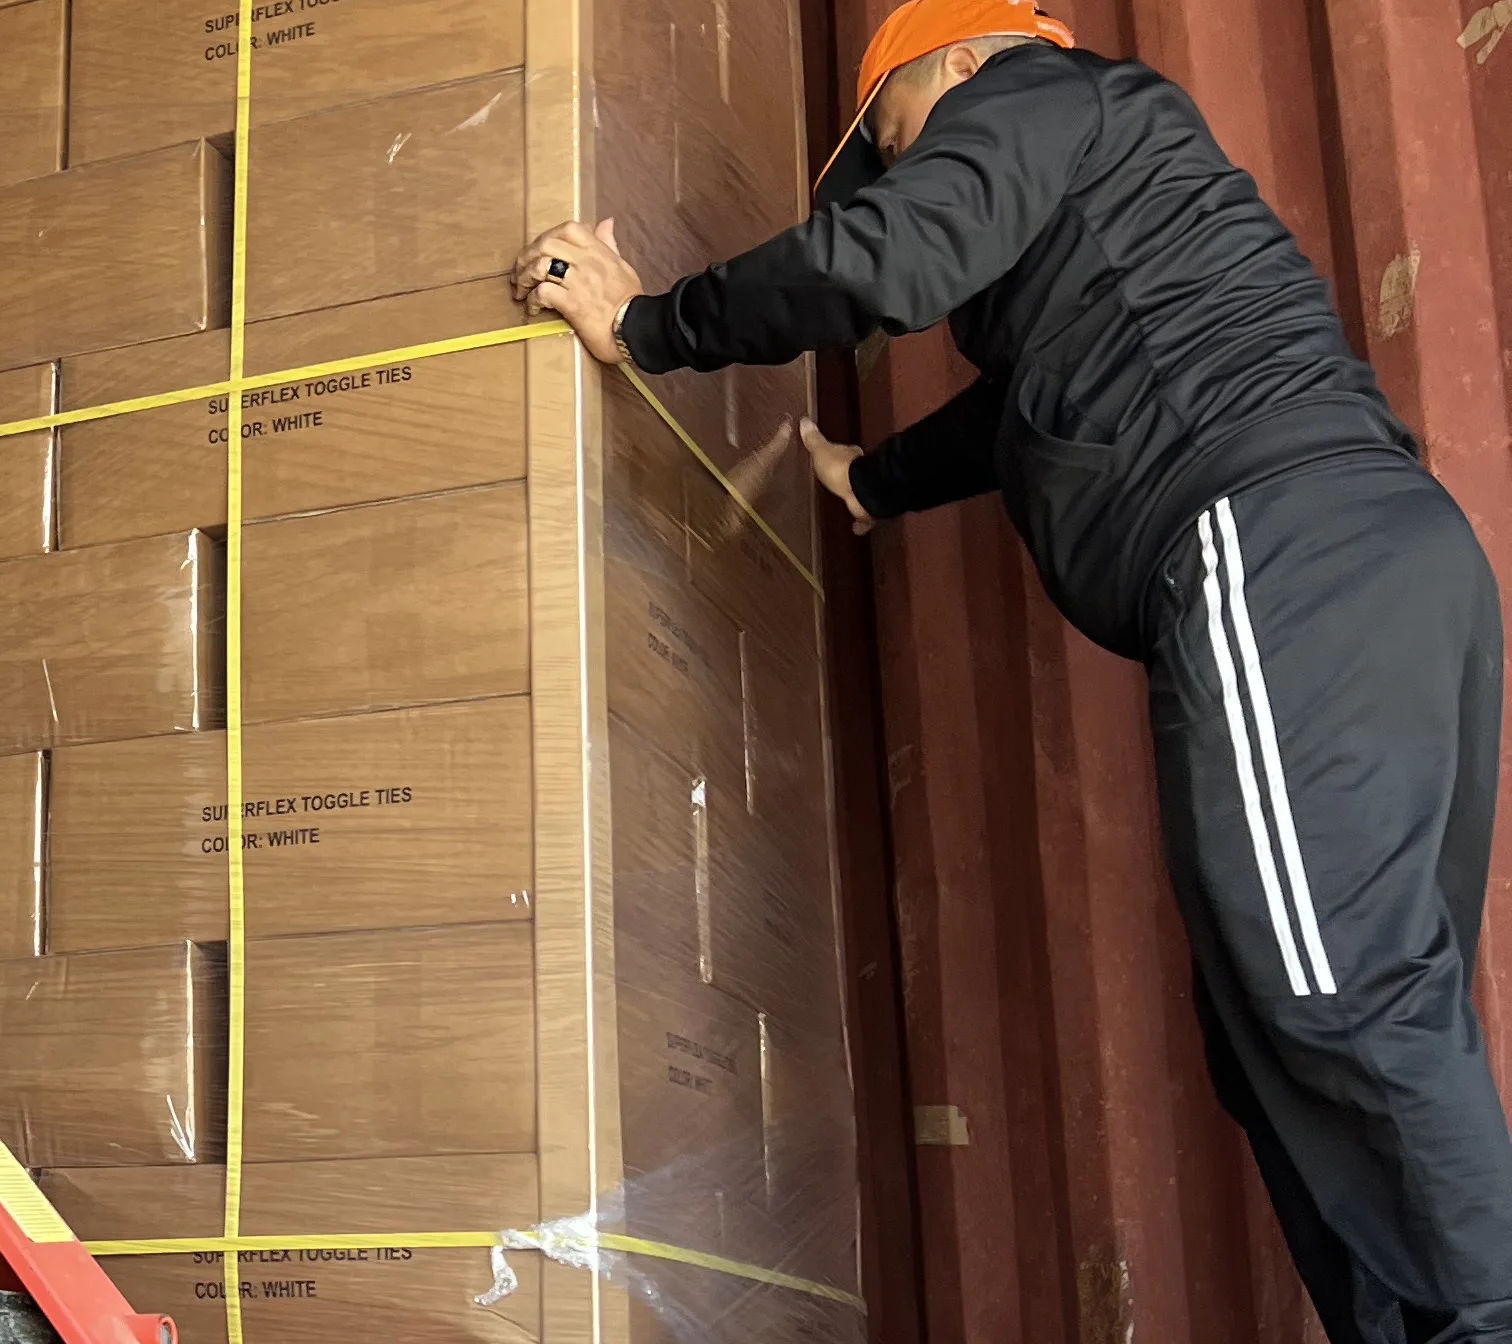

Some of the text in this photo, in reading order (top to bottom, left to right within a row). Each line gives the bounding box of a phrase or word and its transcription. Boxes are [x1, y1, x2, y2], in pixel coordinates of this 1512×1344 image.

[267, 22, 316, 46] WHITE
[208, 366, 412, 414] SUERFLEX TOGGLE TIES
[208, 410, 323, 445] COOR: WHITE
[302, 791, 370, 812] TOGGLE
[375, 787, 413, 805] TIES
[268, 828, 320, 847] WHITE
[261, 1280, 317, 1299] WHITE
